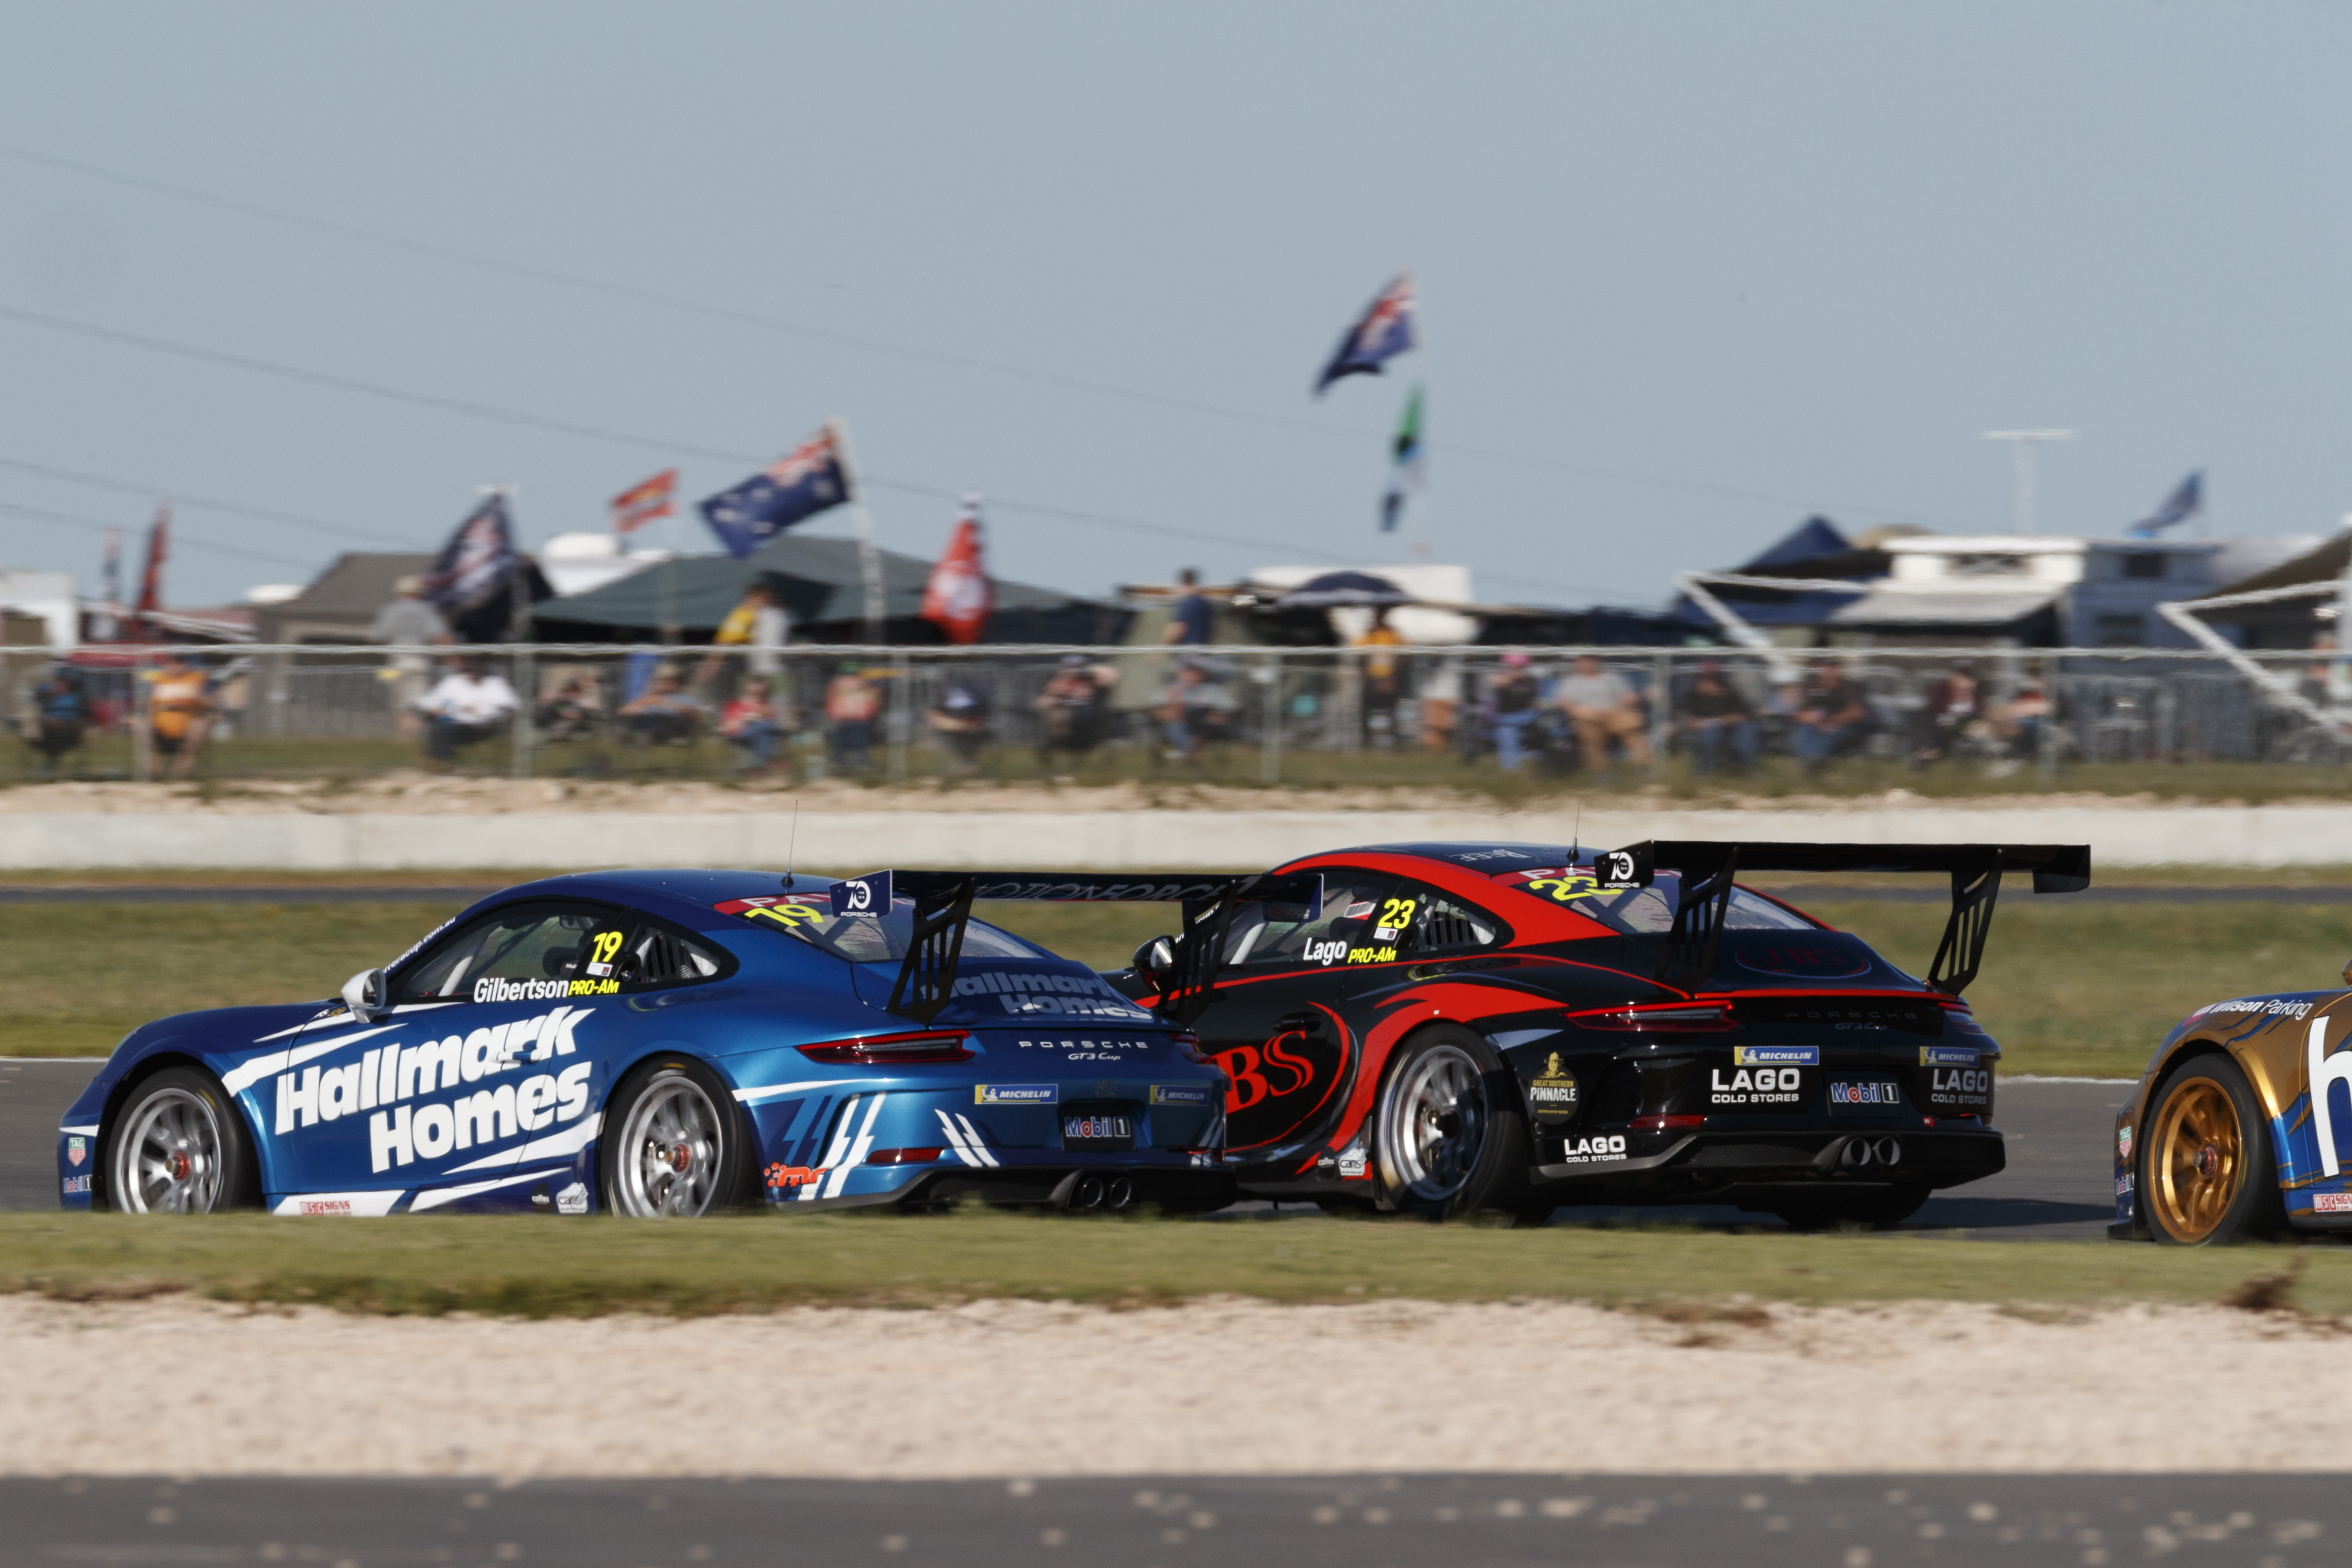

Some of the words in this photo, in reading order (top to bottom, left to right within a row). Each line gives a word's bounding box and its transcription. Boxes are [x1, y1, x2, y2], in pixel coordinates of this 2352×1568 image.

[1609, 852, 1634, 880] 70
[846, 880, 871, 910] 70
[1529, 876, 1622, 901] 23
[744, 904, 824, 927] 19
[1378, 898, 1415, 929] 23
[592, 931, 623, 962] 19
[1303, 937, 1347, 965] Lago
[1347, 947, 1396, 964] PRO-AM
[1763, 947, 1847, 967] JBS
[473, 978, 569, 1003] Gilbertson
[568, 979, 620, 996] PRO-AM
[1000, 994, 1153, 1019] Homes
[2210, 1000, 2264, 1014] Wilson
[2260, 999, 2314, 1020] Parking
[1098, 1052, 1121, 1061] Cup
[1759, 1051, 1812, 1059] MICHELIN
[275, 1005, 596, 1135] Hallmark
[1208, 1030, 1314, 1114] BS
[1712, 1068, 1800, 1091] LAGO
[1933, 1069, 1987, 1092] LAGO
[1000, 1090, 1051, 1098] MICHELIN
[1530, 1087, 1576, 1101] PINNACLE
[1712, 1094, 1746, 1103] COLD
[1750, 1094, 1799, 1102] STORES
[1831, 1083, 1880, 1103] Mobil
[1932, 1094, 1955, 1103] COLD
[1958, 1095, 1986, 1104] STORES
[370, 1062, 592, 1173] Homes
[1065, 1116, 1112, 1138] Mobil
[70, 1139, 83, 1148] TAG
[1564, 1135, 1626, 1156] LAGO
[2120, 1129, 2131, 1141] TAG
[1591, 1154, 1627, 1162] STORES
[63, 1176, 83, 1193] Mobil
[325, 1201, 350, 1210] SIGNS
[2336, 1195, 2352, 1204] SIGN
